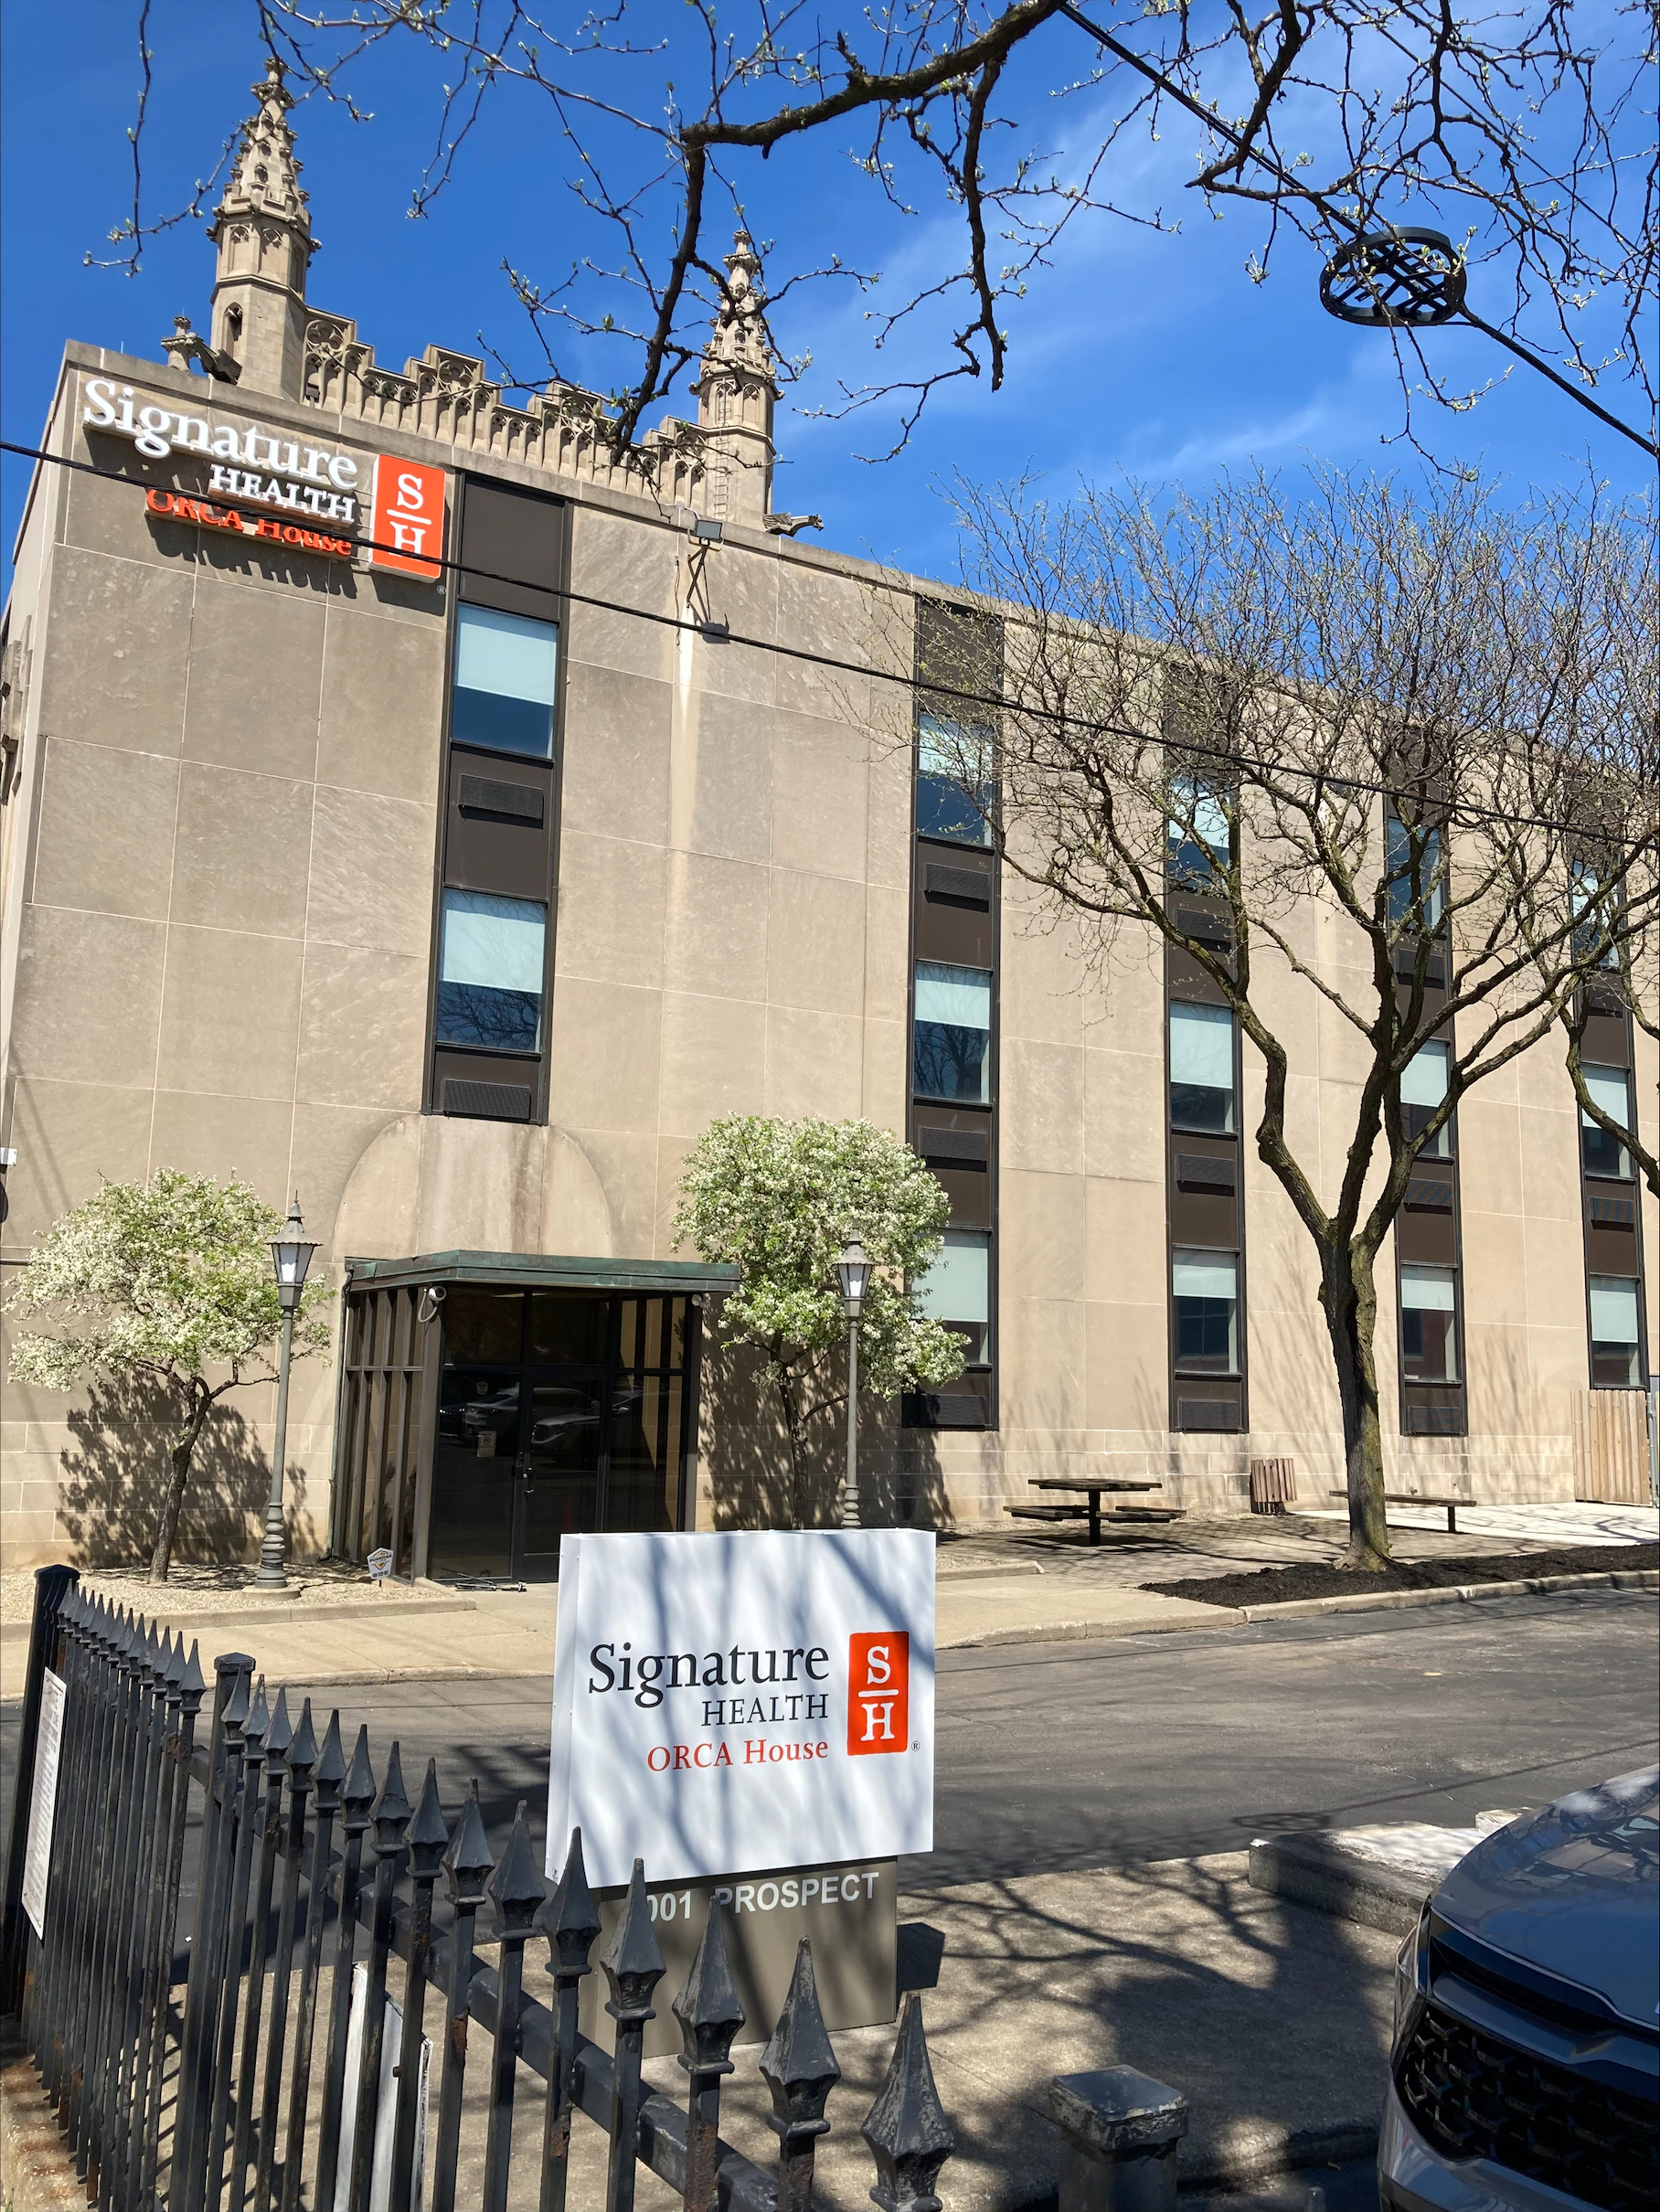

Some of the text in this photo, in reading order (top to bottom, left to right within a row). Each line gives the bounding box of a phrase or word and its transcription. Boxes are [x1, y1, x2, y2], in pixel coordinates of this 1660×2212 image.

[82, 378, 357, 489] Signature
[209, 463, 356, 523] HEALTH
[396, 473, 424, 510] S
[146, 488, 352, 557] ORCA House
[589, 1642, 829, 1708] Signature
[867, 1645, 891, 1686] S
[701, 1694, 829, 1727] HEALTH
[860, 1702, 896, 1741] H
[647, 1739, 829, 1771] ORCA House
[714, 1872, 879, 1914] PROSPECT
